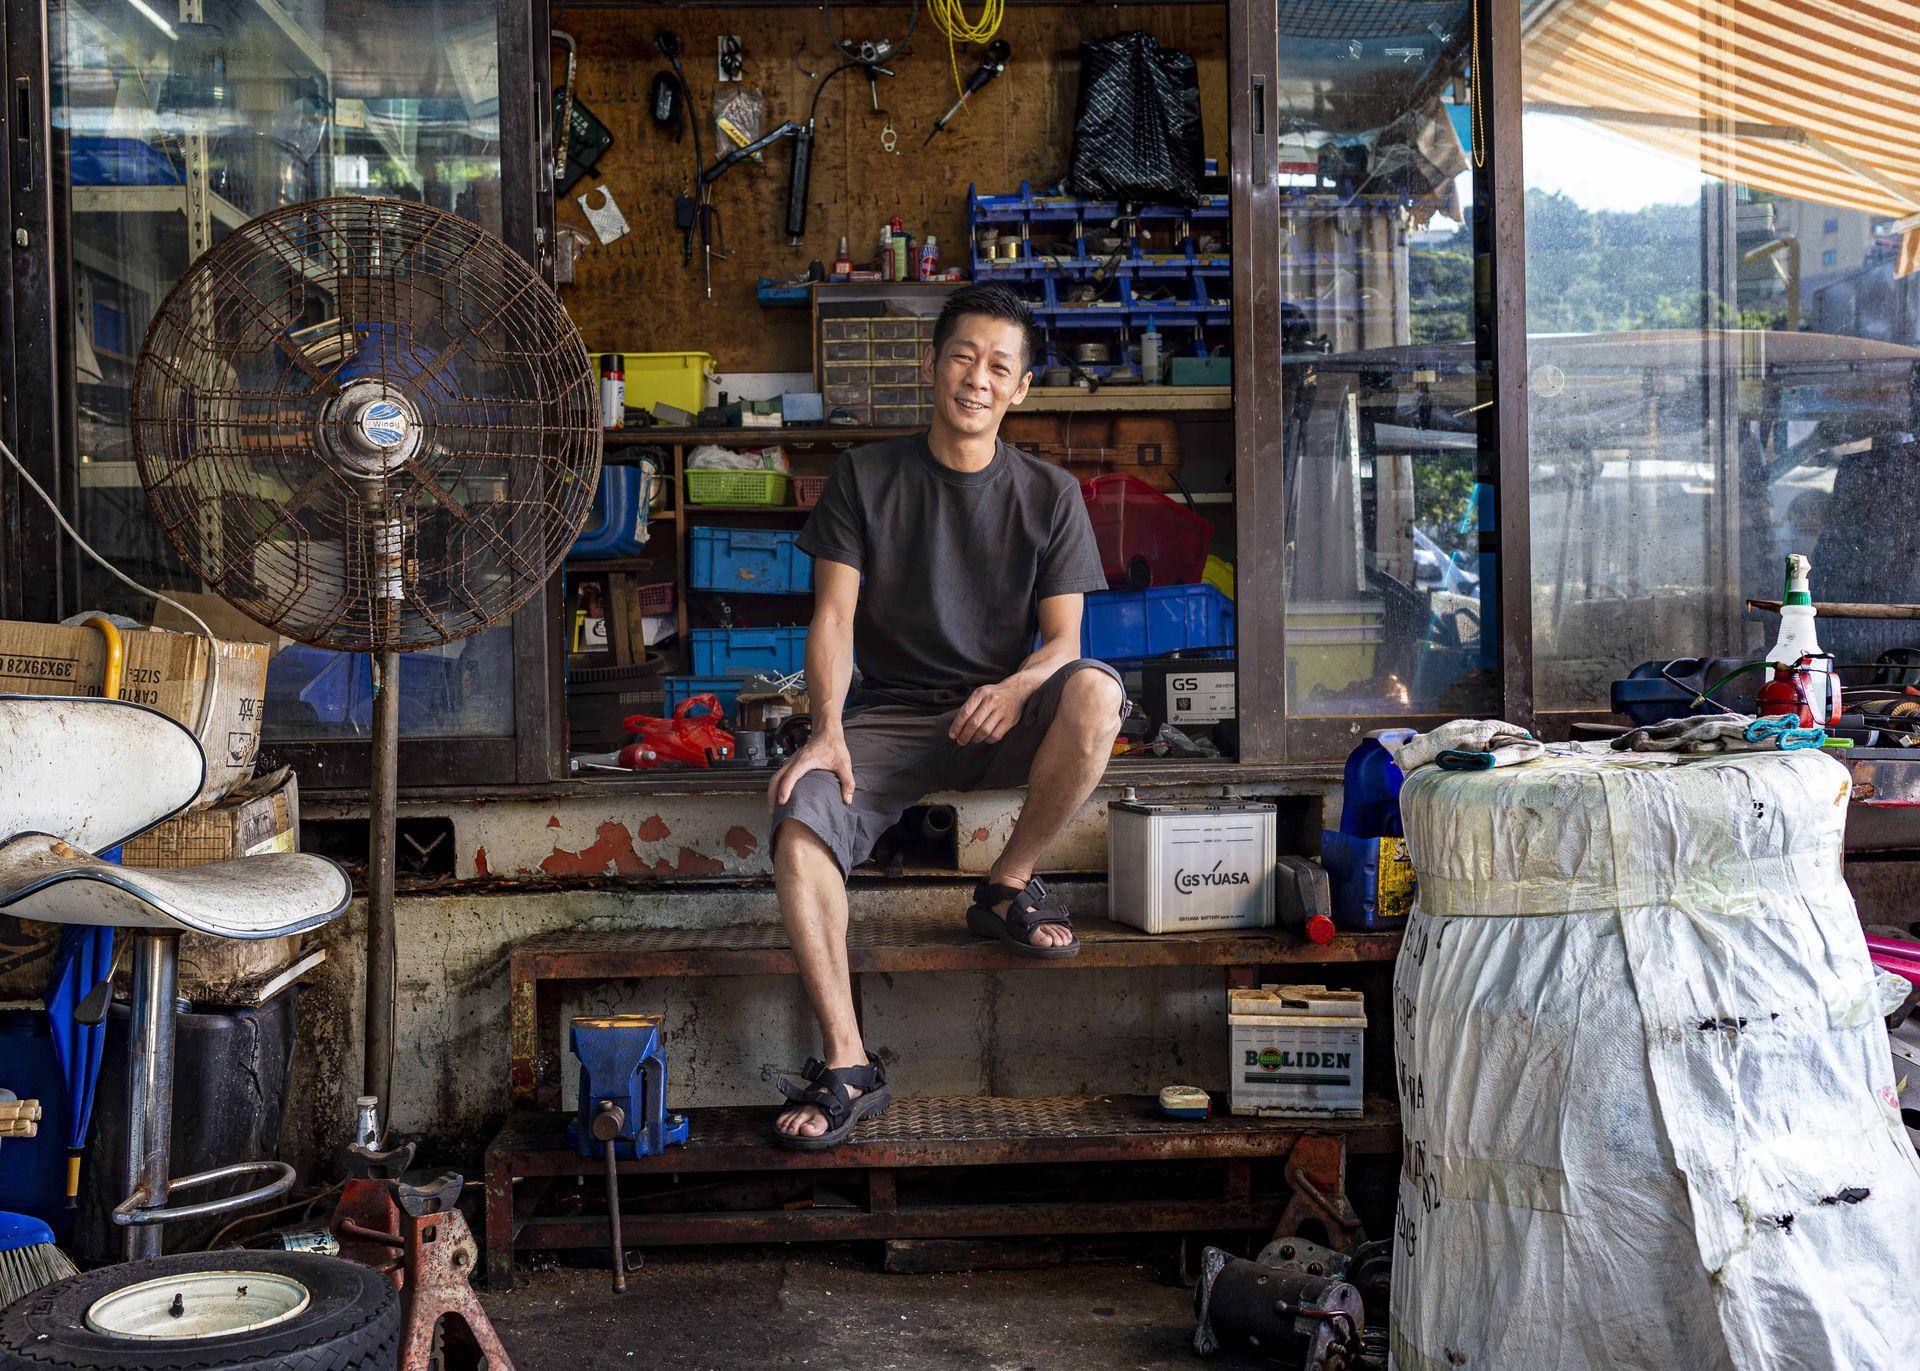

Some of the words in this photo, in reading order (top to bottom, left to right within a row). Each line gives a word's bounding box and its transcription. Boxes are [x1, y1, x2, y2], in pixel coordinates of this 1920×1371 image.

[6, 658, 73, 677] 39X39X28
[129, 667, 161, 684] SIZE:
[1172, 677, 1198, 691] GS
[118, 688, 158, 704] CARTO
